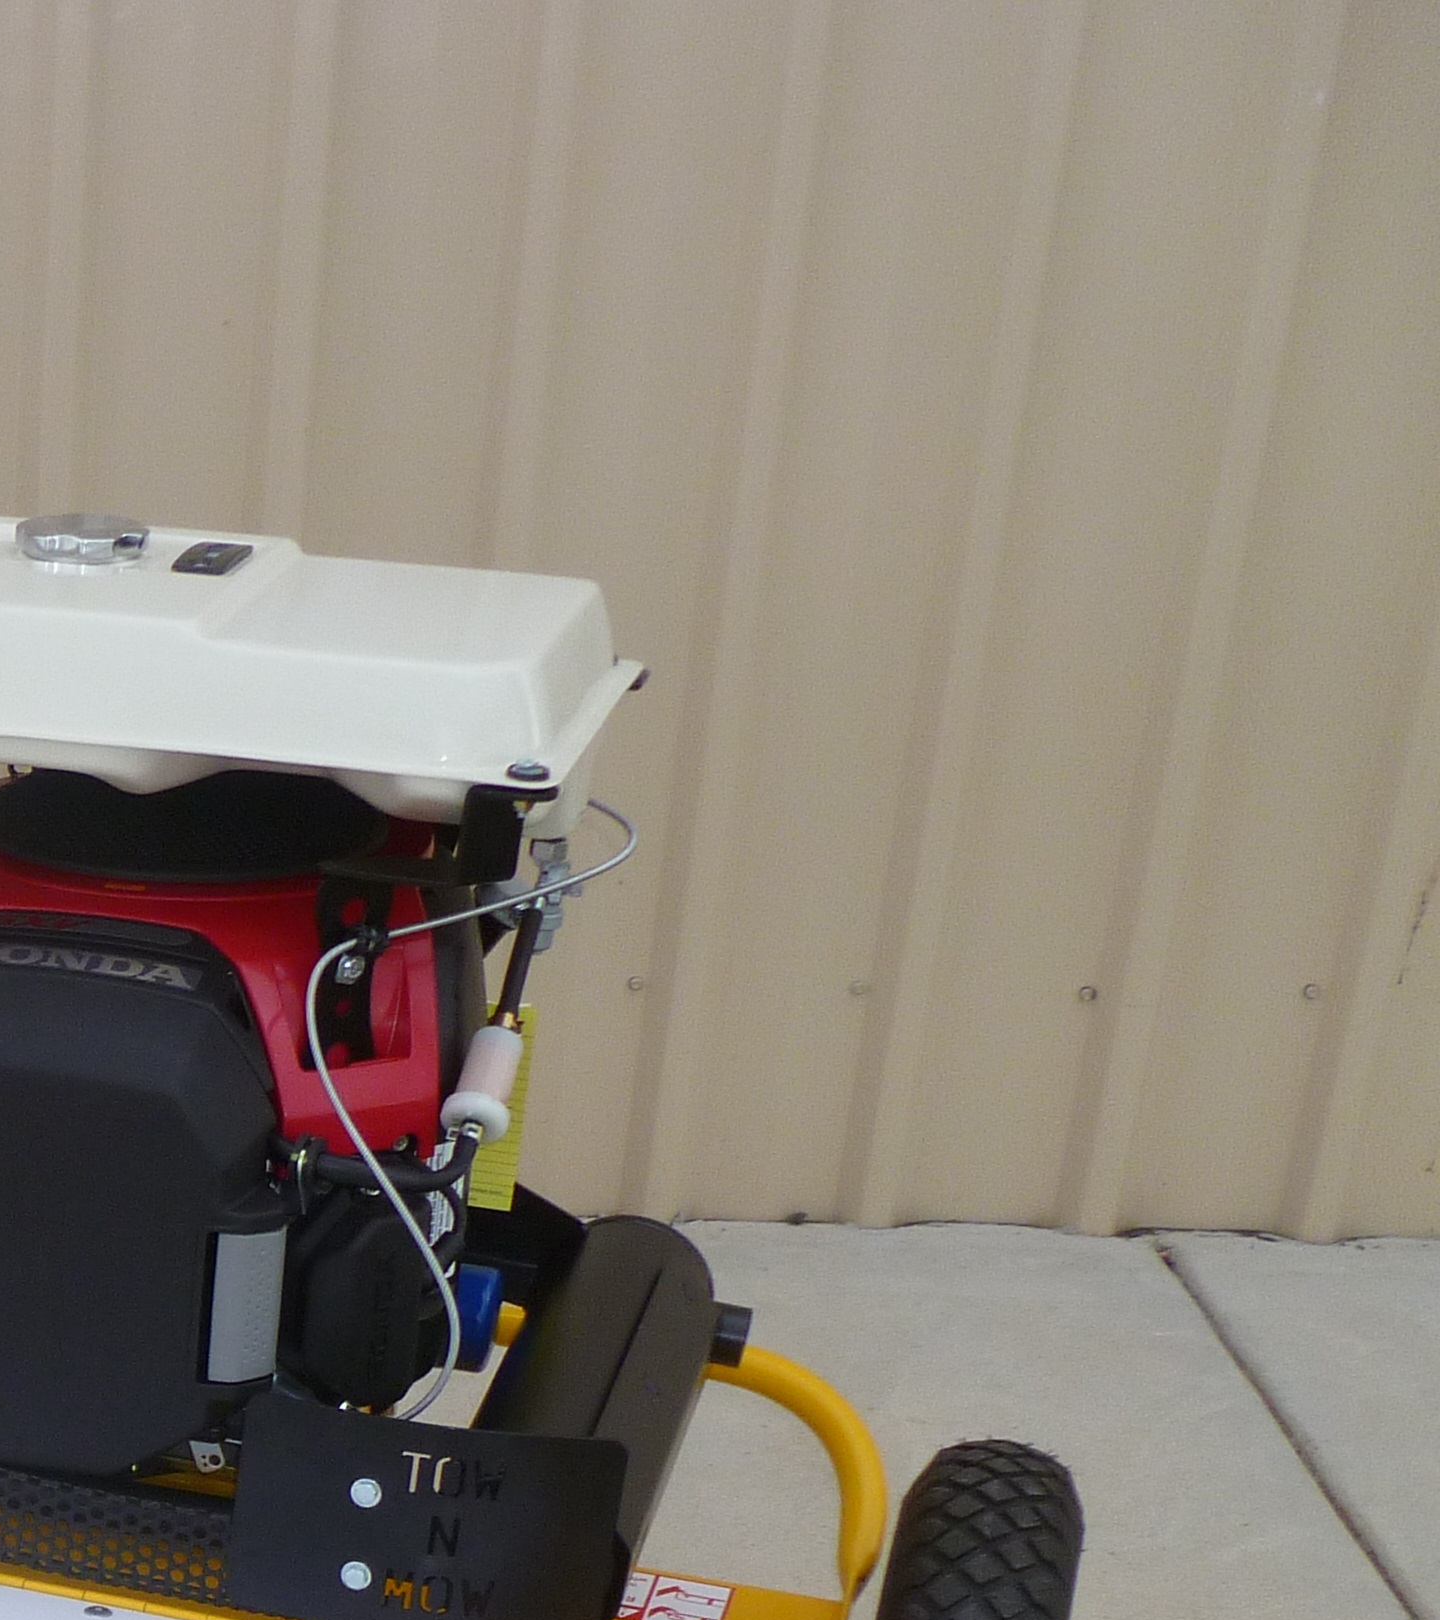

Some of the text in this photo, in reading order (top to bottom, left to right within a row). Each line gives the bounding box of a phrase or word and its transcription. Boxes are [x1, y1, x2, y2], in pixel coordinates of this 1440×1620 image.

[402, 1451, 506, 1500] TOW
[427, 1515, 462, 1557] N
[381, 1567, 495, 1617] MOW
